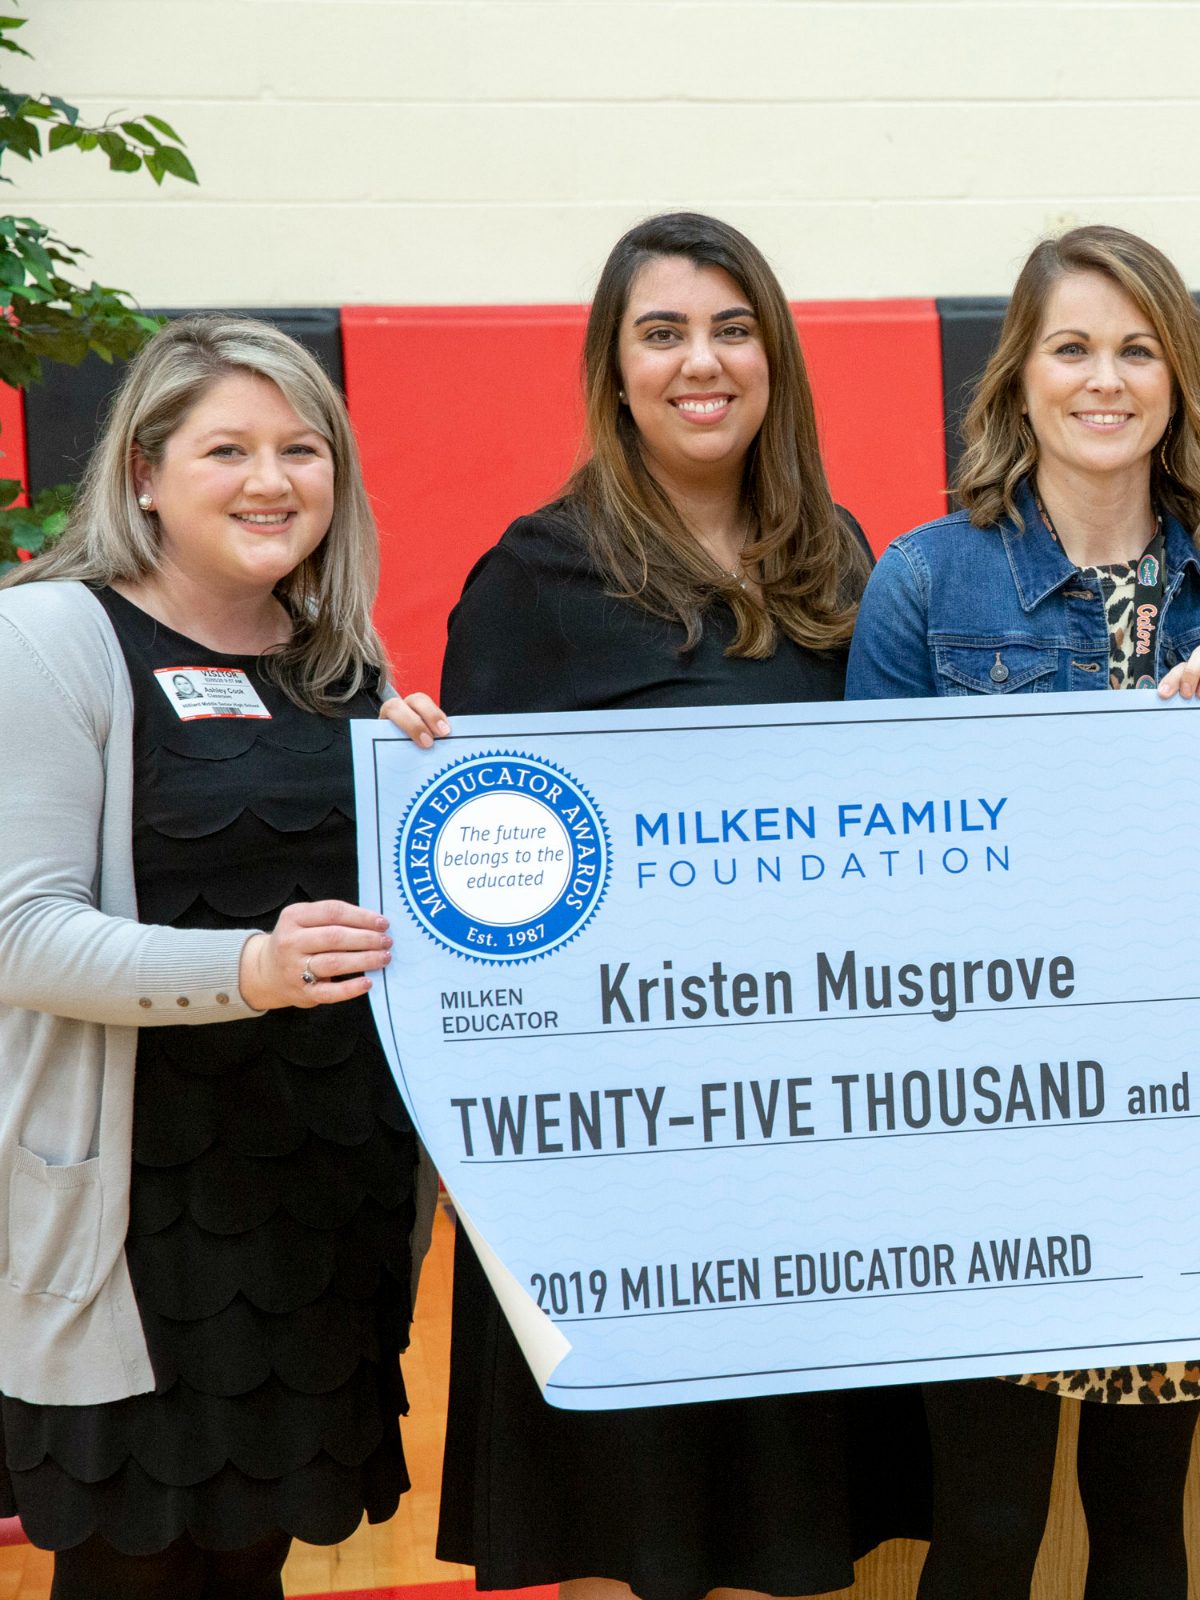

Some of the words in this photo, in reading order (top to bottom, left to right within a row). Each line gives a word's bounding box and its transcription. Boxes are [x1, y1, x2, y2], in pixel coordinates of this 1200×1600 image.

[1136, 604, 1158, 655] Gators
[200, 670, 239, 679] VISITOR
[205, 687, 226, 695] Ashley
[635, 805, 816, 847] MILKEN
[837, 796, 1008, 838] FAMILY
[410, 817, 447, 918] MILKEN
[429, 767, 563, 815] EDUCATOR
[561, 805, 596, 911] AWARDS
[459, 826, 491, 843] The
[494, 824, 547, 845] future
[443, 850, 509, 868] belongs
[515, 849, 531, 864] to
[537, 846, 564, 863] the
[637, 844, 1011, 889] FOUNDATION
[466, 869, 545, 889] educated
[466, 927, 498, 947] Est.
[507, 923, 546, 948] 1987
[441, 988, 523, 1009] MILKEN
[600, 960, 793, 1025] Kristen
[816, 950, 1075, 1022] Musgrove
[442, 1010, 559, 1034] EDUCATOR
[450, 1076, 815, 1158] TWENTY-FIVE
[831, 1059, 1106, 1138] THOUSAND
[1127, 1071, 1190, 1115] and
[530, 1269, 607, 1315] 2019
[621, 1257, 760, 1311] MILKEN
[774, 1243, 955, 1298] EDUCATOR
[967, 1233, 1092, 1284] AWARD
